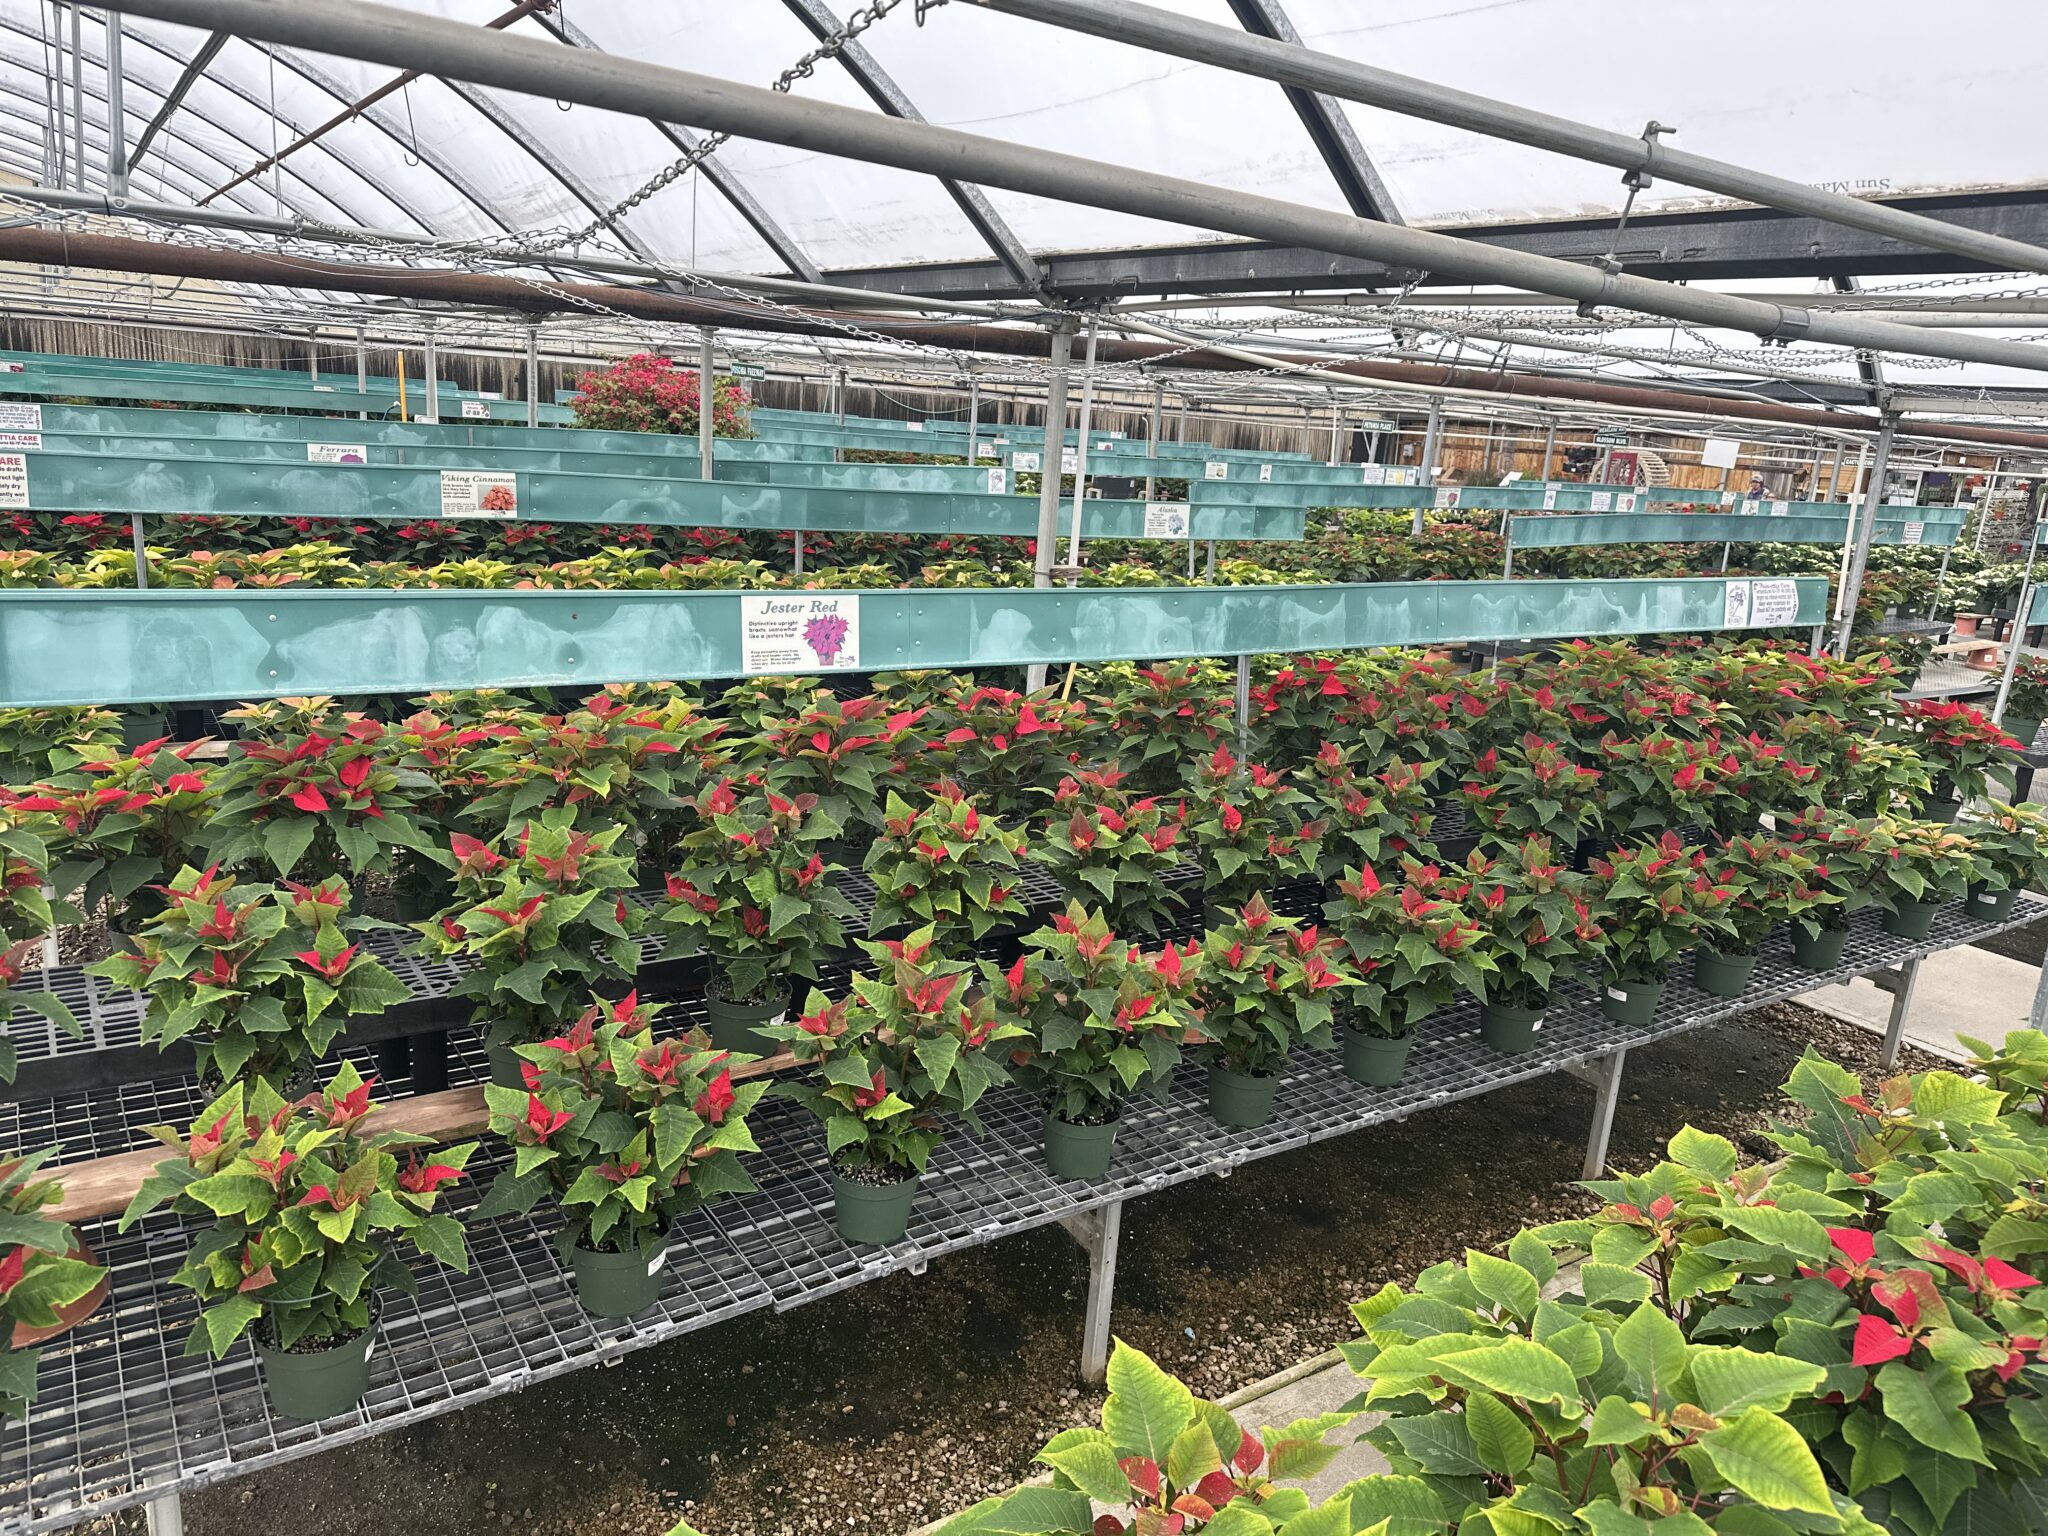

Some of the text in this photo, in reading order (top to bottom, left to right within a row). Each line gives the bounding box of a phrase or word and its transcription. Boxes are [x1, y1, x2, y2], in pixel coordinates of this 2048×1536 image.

[1856, 178, 1890, 190] Sun
[1380, 422, 1392, 430] PLACE
[1596, 436, 1615, 444] BLOSSOM
[320, 445, 358, 453] Ferrara
[12, 474, 25, 482] light
[441, 474, 515, 484] Viking Cinnamon
[761, 600, 839, 615] Jester Red
